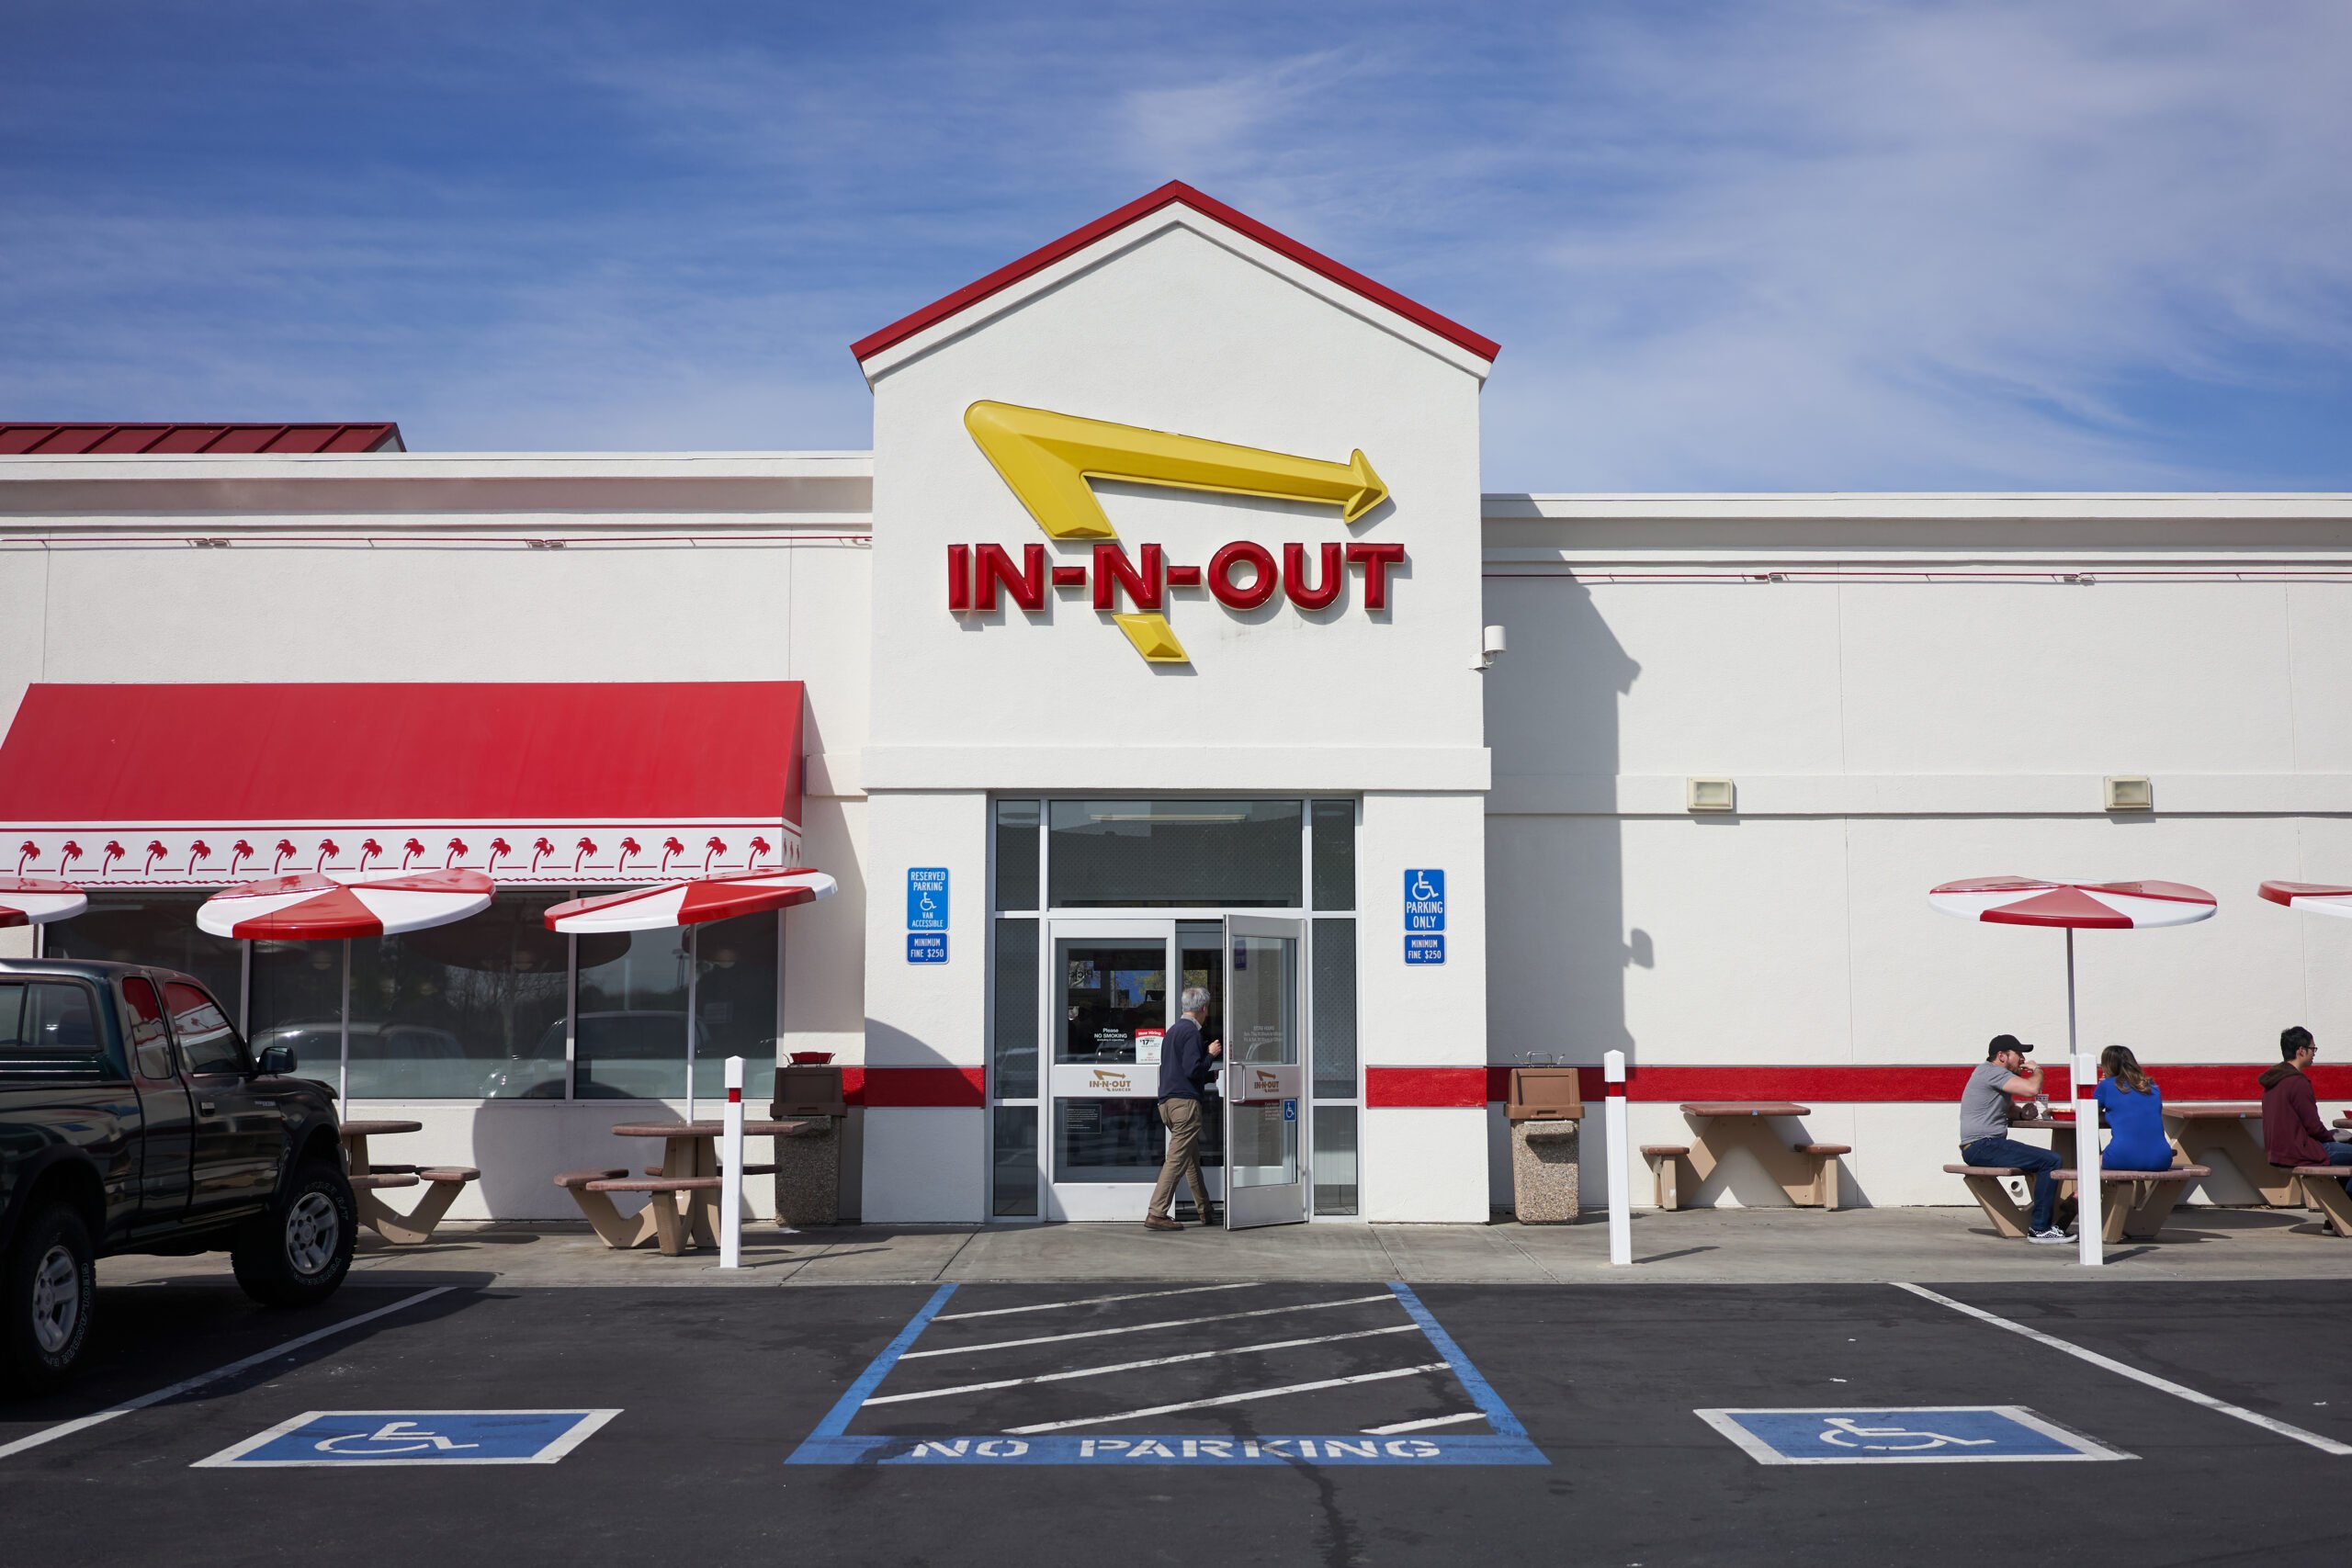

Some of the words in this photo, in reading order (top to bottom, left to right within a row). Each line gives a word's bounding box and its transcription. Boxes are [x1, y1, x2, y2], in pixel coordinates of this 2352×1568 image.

[947, 541, 1405, 611] IN-N-OUT
[910, 871, 945, 881] RESERVED
[912, 882, 944, 891] PARKING
[1406, 901, 1443, 914] PARKING
[922, 911, 933, 919] VAN
[911, 919, 944, 928] ACCESSIBLE
[1413, 916, 1437, 929] ONLY
[914, 938, 941, 946] MINIMUM
[1411, 940, 1438, 948] MINIMUM
[910, 949, 924, 958] FINE
[927, 949, 944, 958] $250
[1408, 950, 1421, 959] FINE
[1424, 950, 1442, 959] $250
[910, 1439, 1029, 1458] NO
[1080, 1439, 1442, 1458] PARKING
